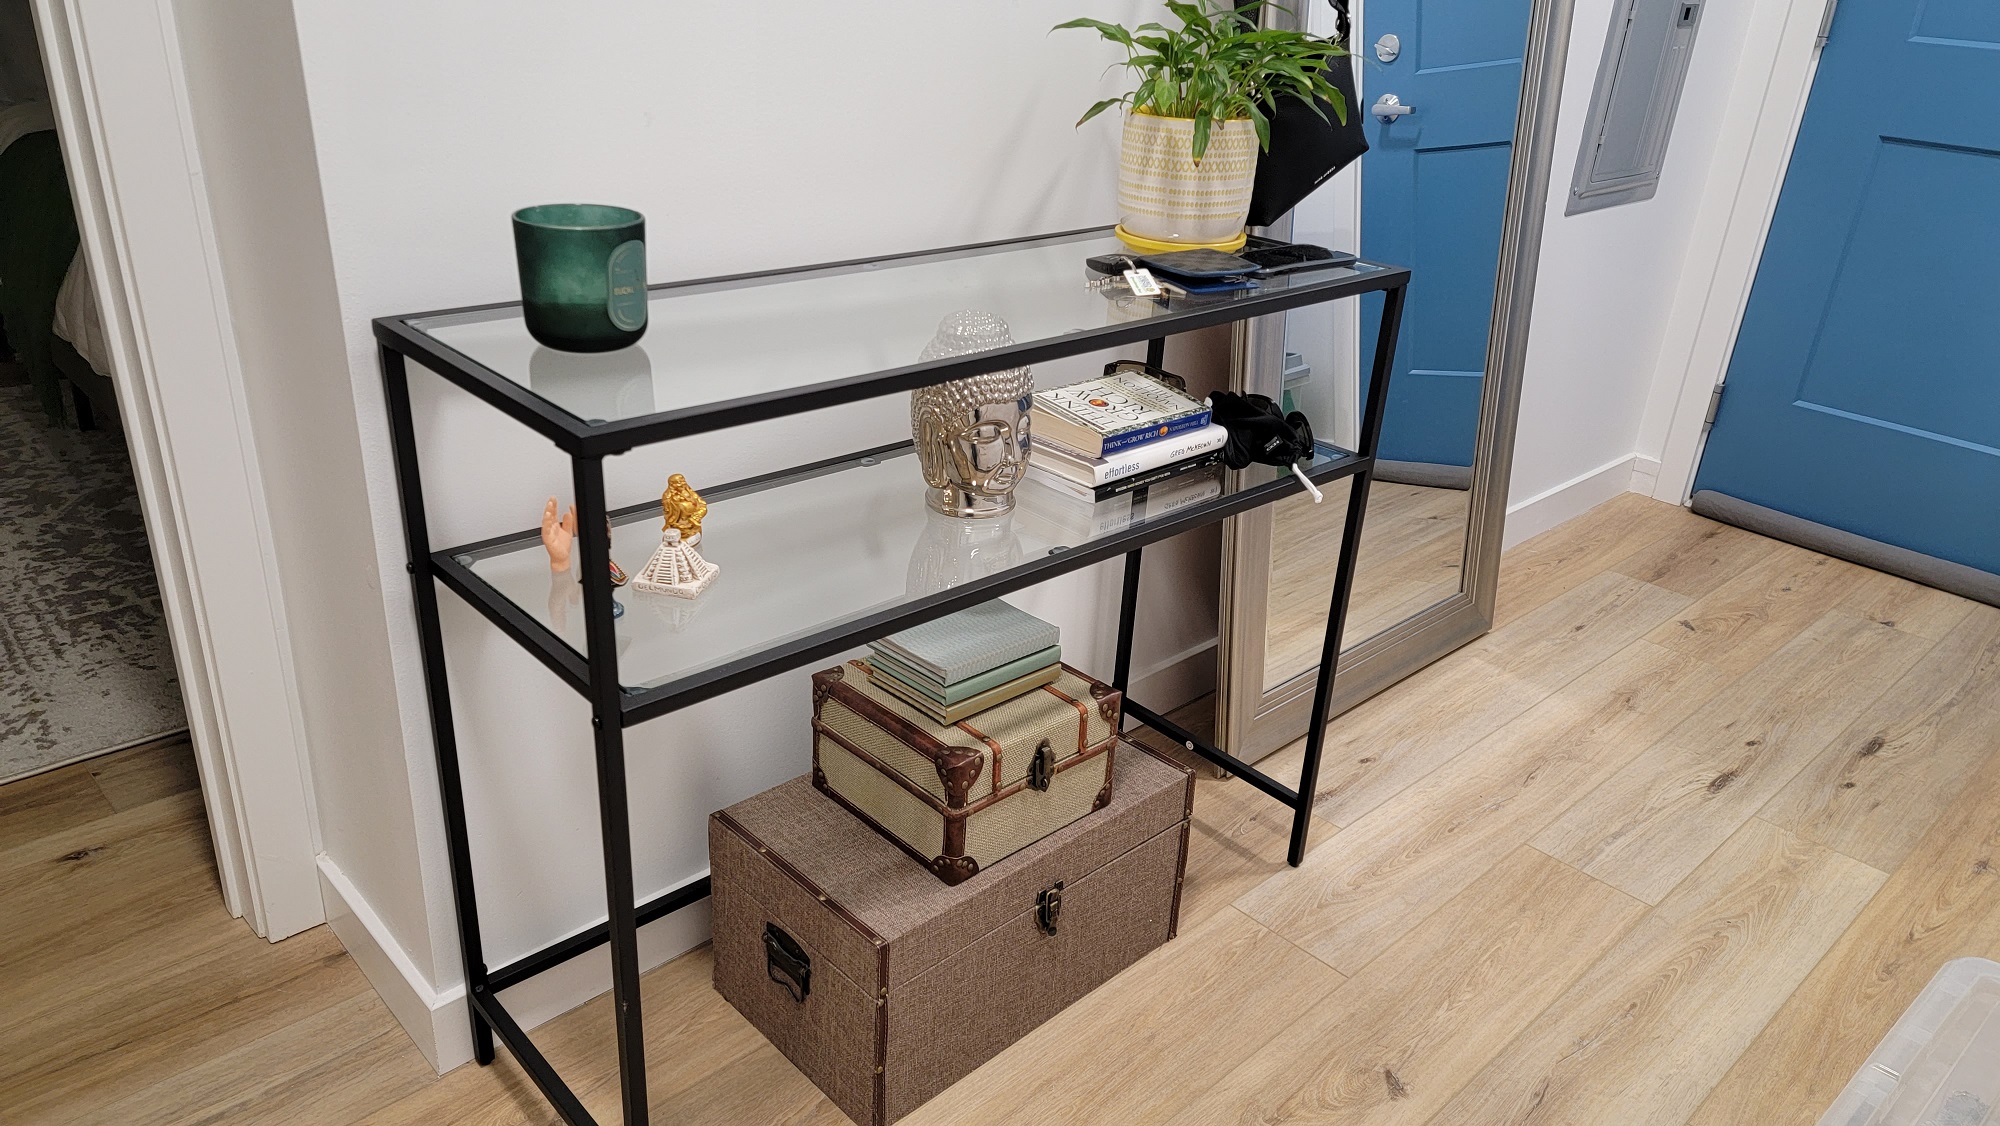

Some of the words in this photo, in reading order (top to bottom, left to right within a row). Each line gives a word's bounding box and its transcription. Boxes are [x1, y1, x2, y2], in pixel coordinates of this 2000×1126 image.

[1089, 386, 1153, 415] RICH
[1112, 377, 1185, 410] NAPOLEON
[1143, 384, 1174, 398] HILL
[1043, 392, 1118, 427] THINK
[1063, 389, 1139, 421] GROW
[1104, 440, 1121, 450] THINK
[1127, 433, 1145, 444] GROW
[1144, 430, 1159, 440] RICH
[1169, 448, 1186, 459] GREG
[1104, 462, 1140, 480] effortless
